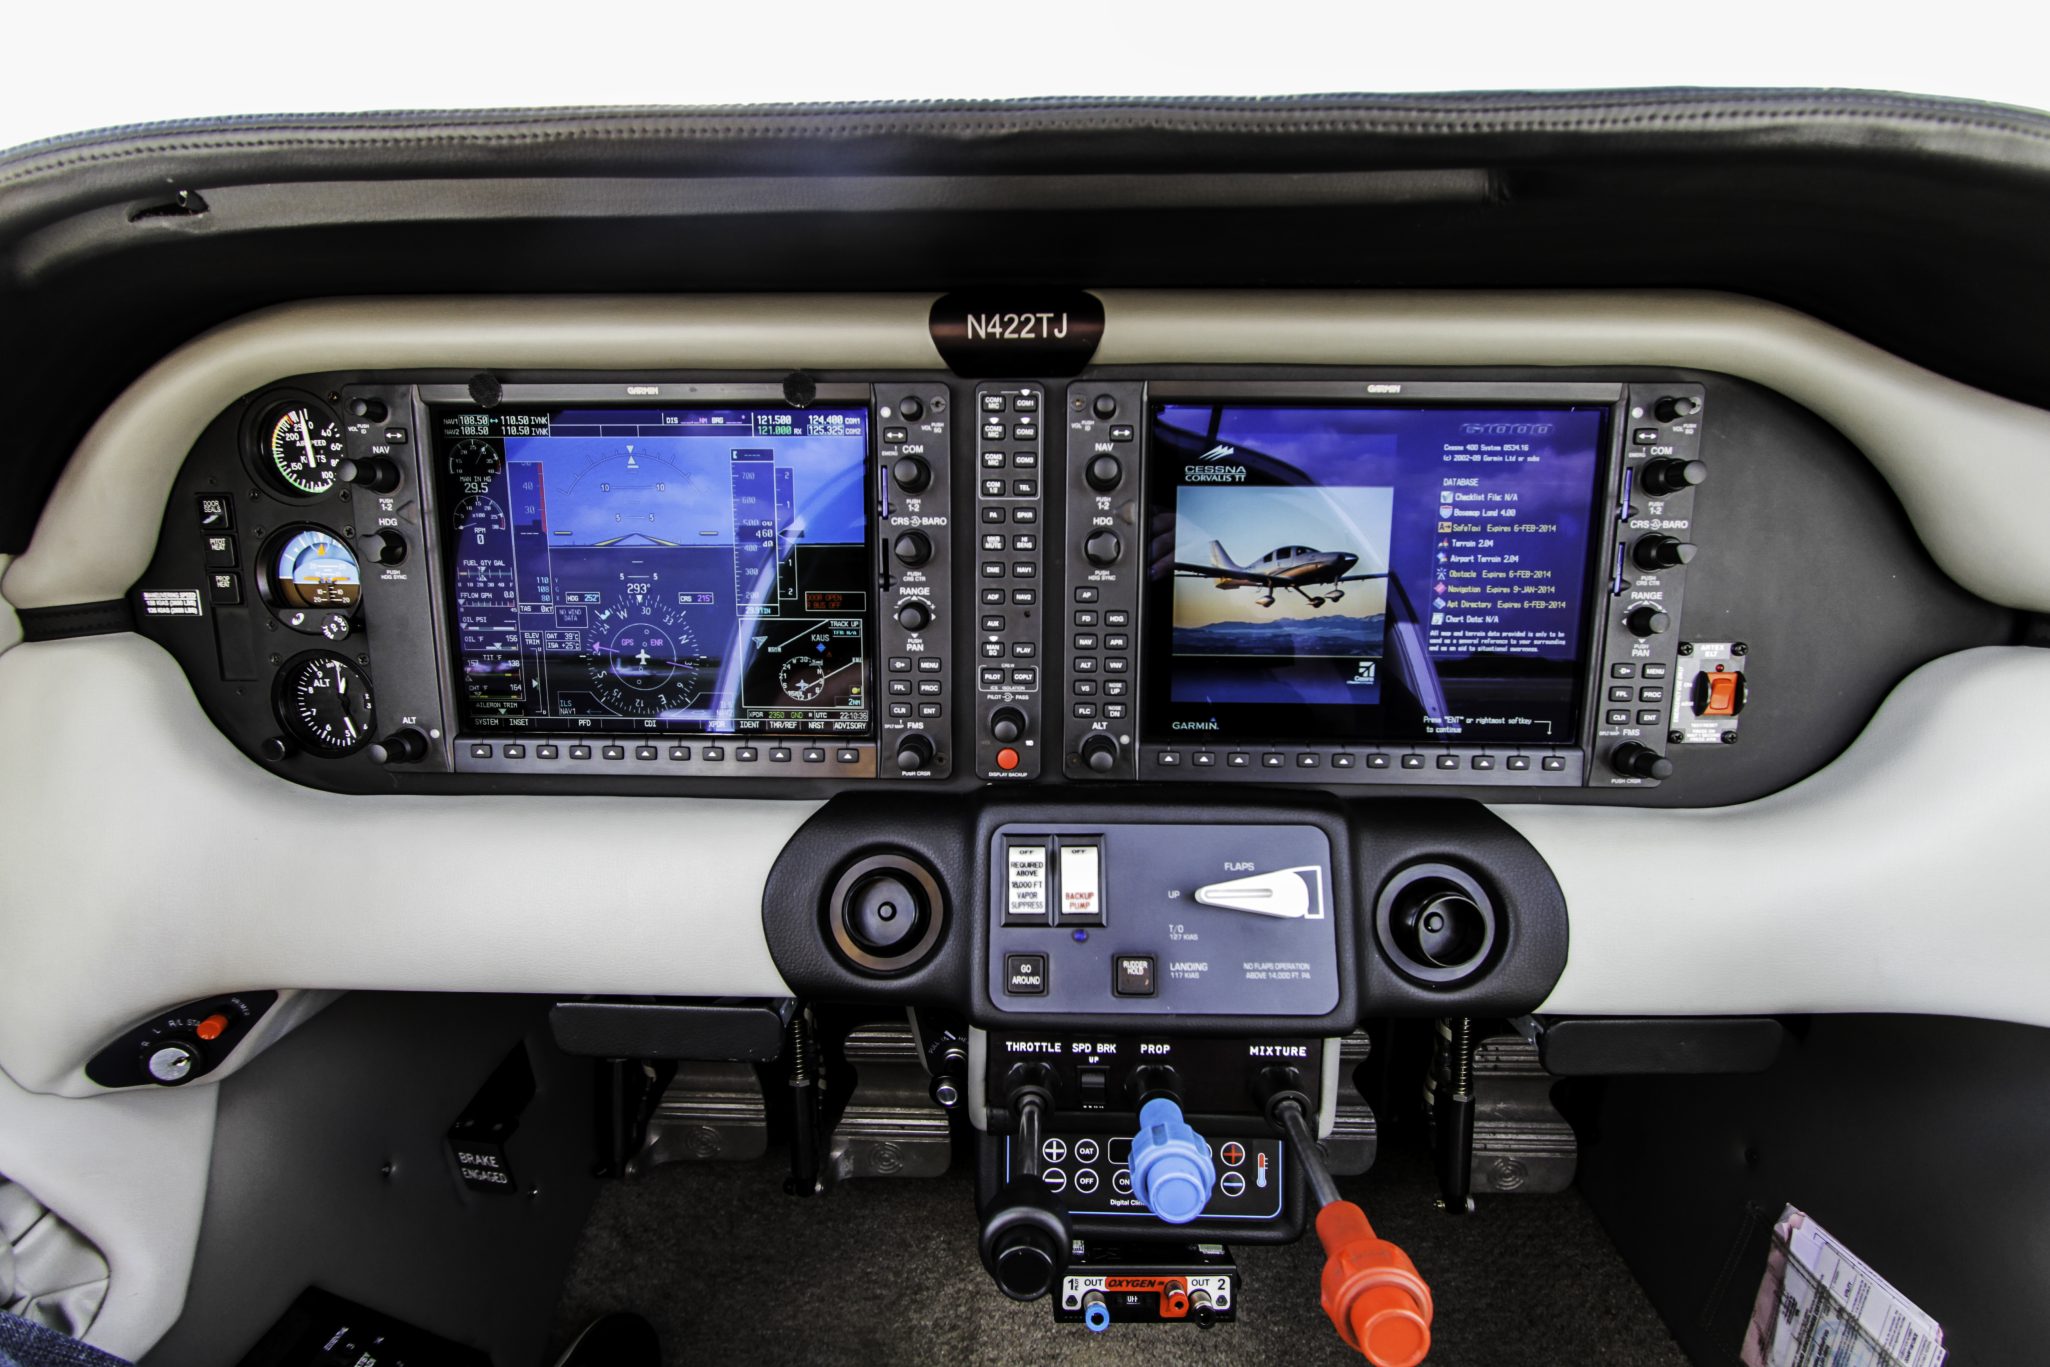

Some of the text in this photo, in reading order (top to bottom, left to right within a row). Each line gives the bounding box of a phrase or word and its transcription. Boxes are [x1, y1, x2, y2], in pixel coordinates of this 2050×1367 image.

[968, 313, 1067, 339] N422TJ
[1367, 385, 1401, 393] GARMIN
[460, 416, 488, 425] 108.50
[501, 416, 529, 425] 110.50
[757, 415, 791, 424] 121.500
[461, 427, 489, 435] 108.50
[502, 427, 529, 435] 110.50
[809, 426, 843, 435] 125.325
[902, 445, 923, 453] COM
[1095, 443, 1113, 451] NAV
[523, 482, 533, 490] 40
[1443, 478, 1479, 486] DATABASE
[465, 483, 488, 493] 29.5
[601, 484, 609, 492] 10
[1455, 493, 1484, 501] Checklist
[524, 506, 535, 514] 30
[1098, 502, 1109, 510] 1-2
[379, 518, 397, 526] HDG
[1093, 517, 1112, 525] HDG
[627, 584, 650, 593] 293°
[641, 607, 650, 615] 30
[314, 679, 330, 687] ALT
[835, 722, 866, 730] ADVISORY
[1172, 722, 1217, 730] GARMIN
[1224, 863, 1255, 871] FLAPS
[1169, 925, 1183, 933] T/O
[1021, 965, 1031, 973] GO
[1170, 963, 1208, 971] LANDING
[1006, 1042, 1061, 1052] THROTTLE
[1072, 1043, 1116, 1053] SPD BRK
[1141, 1044, 1170, 1054] PROP
[1250, 1046, 1306, 1057] MIXTURE
[458, 1152, 499, 1167] BRAKE
[462, 1168, 507, 1183] ENGAGED
[1068, 1279, 1074, 1290] 1
[1109, 1280, 1156, 1288] OXYGEN
[1218, 1279, 1225, 1290] 2
